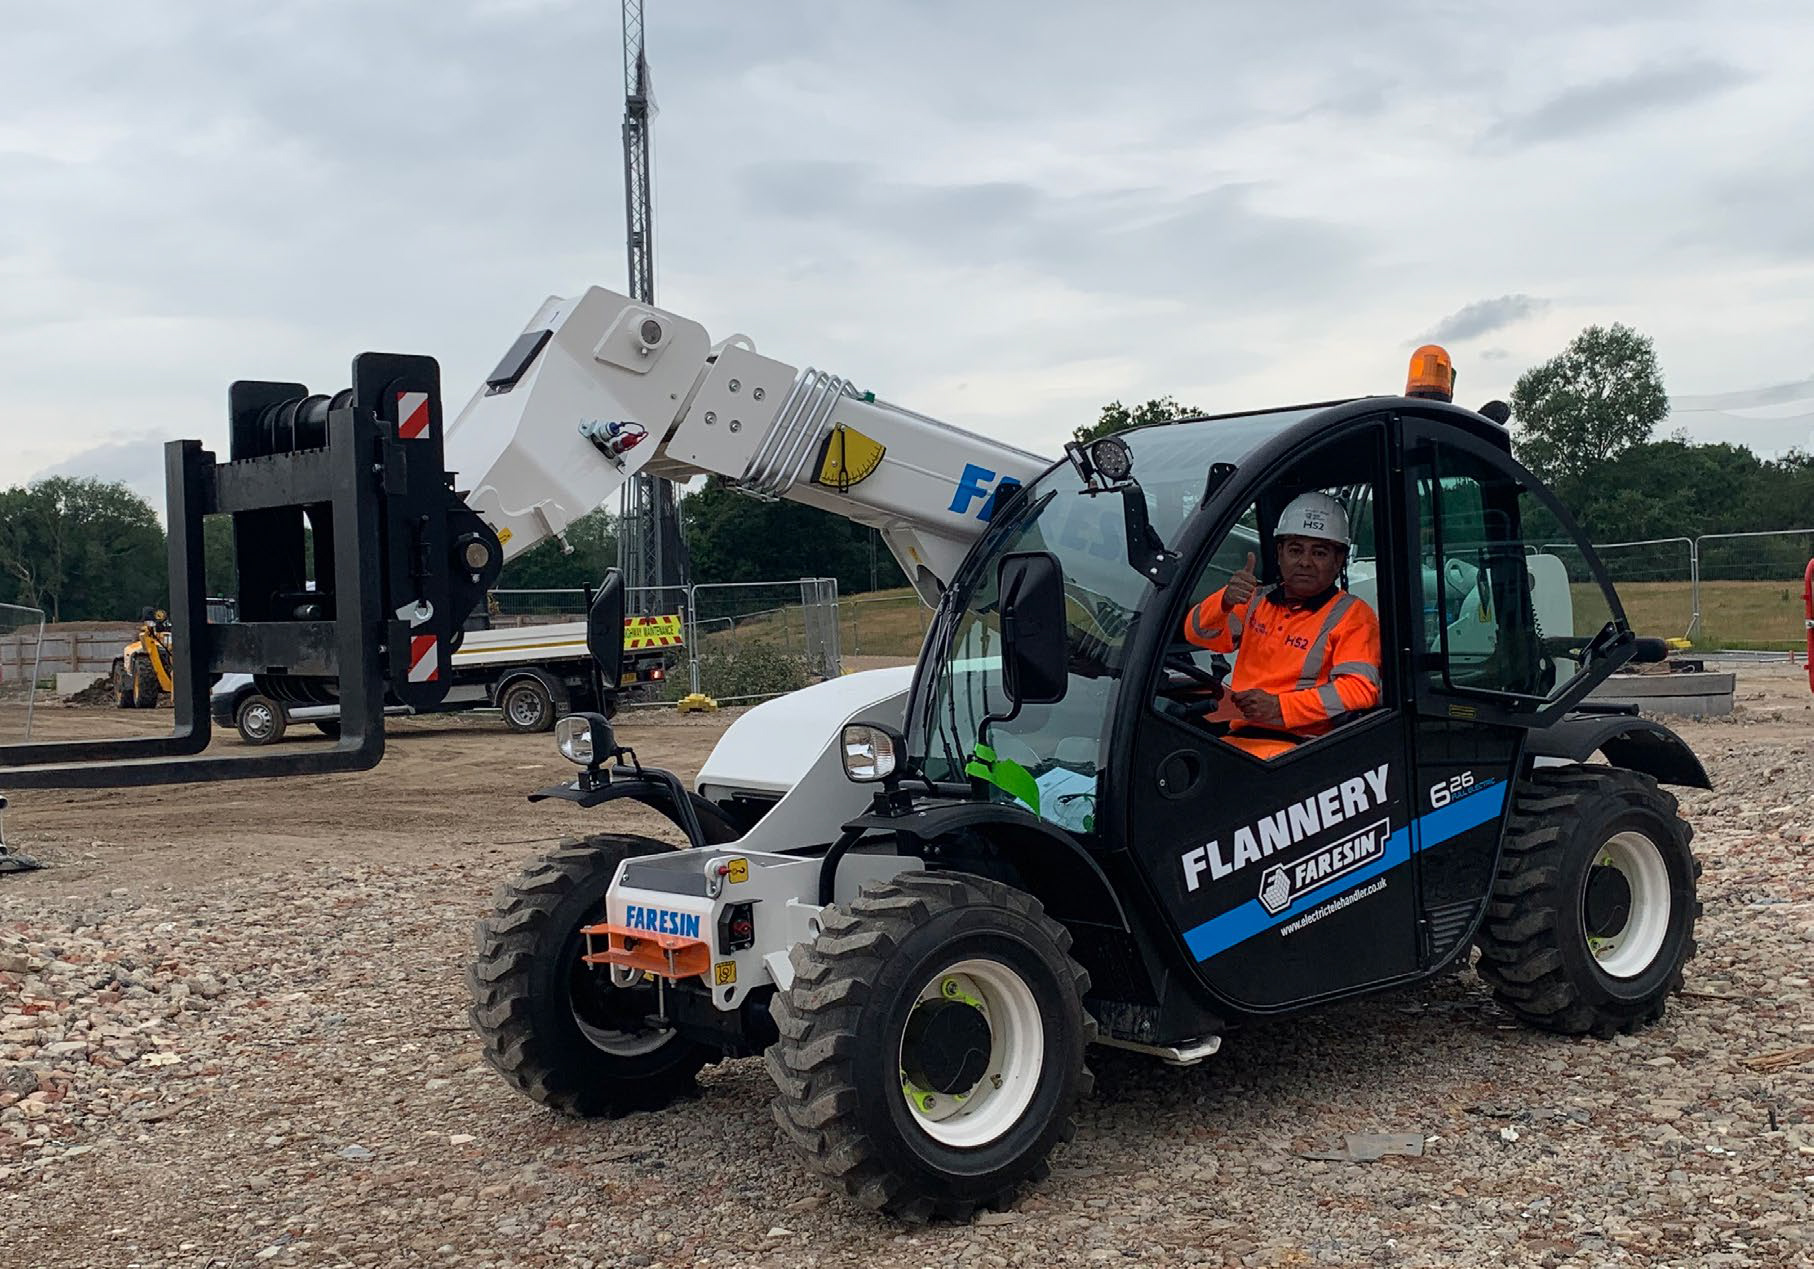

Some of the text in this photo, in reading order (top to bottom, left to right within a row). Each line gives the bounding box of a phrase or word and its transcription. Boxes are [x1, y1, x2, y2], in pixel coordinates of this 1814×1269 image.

[1303, 520, 1325, 531] HS2
[1285, 634, 1309, 650] HS2
[1181, 763, 1390, 892] FLANNERY
[1295, 830, 1376, 889] FARESIN
[625, 905, 701, 938] FARESIN
[1280, 877, 1388, 937] www.electrictelehandler.co.uk
